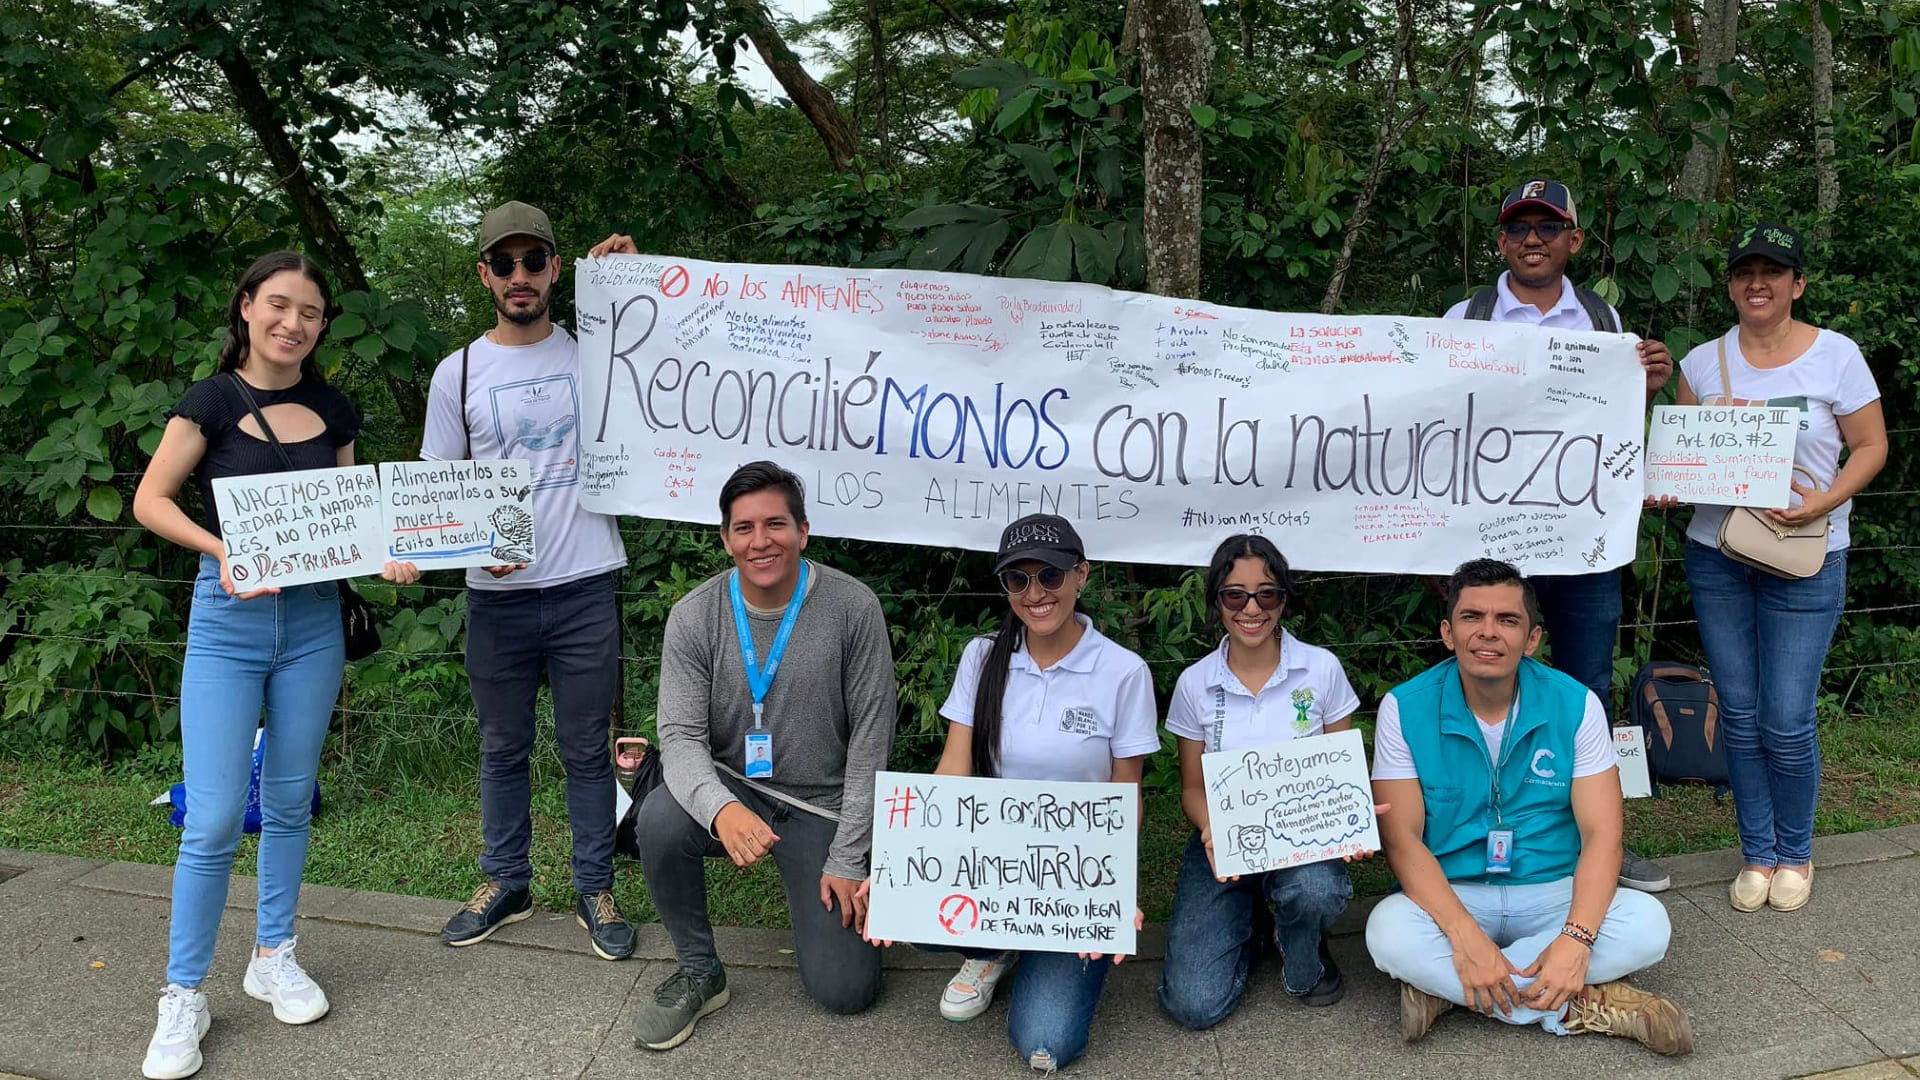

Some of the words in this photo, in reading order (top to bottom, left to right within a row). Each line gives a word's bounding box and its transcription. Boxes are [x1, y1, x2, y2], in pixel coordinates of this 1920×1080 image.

[1661, 411, 1686, 429] Ley
[1767, 409, 1790, 424] III
[1677, 433, 1705, 447] Art
[1745, 432, 1777, 448] #2
[1213, 397, 1261, 488] la
[1285, 392, 1607, 518] naturaleza
[392, 461, 493, 487] Alimentarlos
[501, 466, 517, 478] es
[1647, 467, 1703, 481] alimentos
[1708, 473, 1717, 481] a
[1724, 466, 1735, 480] la
[1744, 466, 1779, 481] fauna
[228, 479, 331, 516] NACIMOS
[335, 473, 375, 497] PARA
[484, 488, 494, 499] a
[501, 486, 517, 497] su
[816, 469, 884, 509] LOS
[924, 477, 1140, 524] ALIMENTES
[292, 505, 314, 522] LA
[276, 528, 300, 546] NO
[308, 514, 357, 541] PARA
[395, 531, 434, 553] Evita
[440, 521, 488, 545] hacerlo
[1220, 795, 1234, 811] a
[1241, 789, 1268, 806] los
[1276, 774, 1335, 798] monos
[1273, 800, 1325, 818] recordemos
[1328, 792, 1353, 806] evitar
[956, 795, 990, 833] ME
[1000, 793, 1124, 835] COMPROMETO
[1276, 812, 1319, 830] alimentar
[1321, 801, 1360, 819] nuestros
[1299, 818, 1342, 835] monitos
[903, 847, 942, 887] NO
[979, 896, 1000, 914] NO
[1024, 896, 1080, 918] TRÁFICO
[981, 918, 997, 932] DE
[1000, 917, 1045, 937] FAUNA
